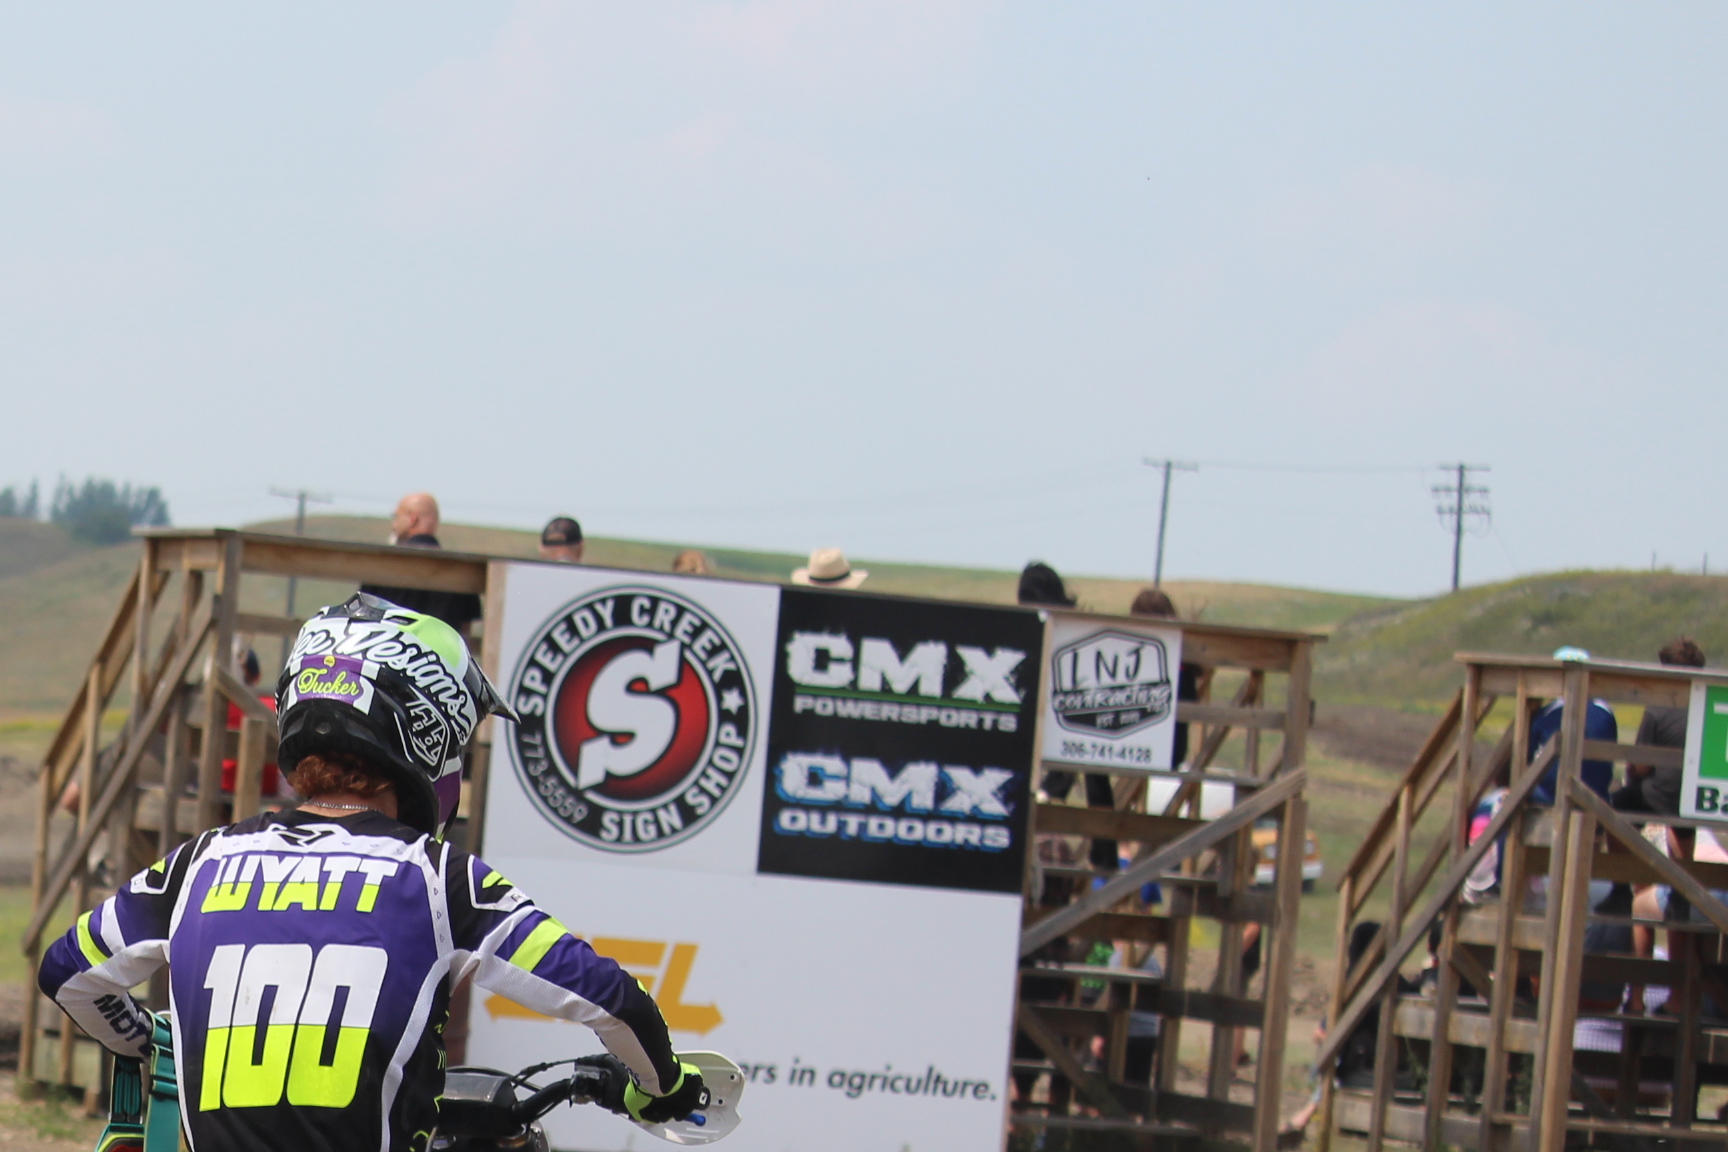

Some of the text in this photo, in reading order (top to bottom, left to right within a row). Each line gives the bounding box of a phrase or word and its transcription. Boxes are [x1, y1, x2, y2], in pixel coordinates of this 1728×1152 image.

[296, 667, 360, 697] Tucker
[335, 622, 474, 741] Designs
[516, 595, 738, 717] SPEEDY CREEK
[785, 630, 1027, 704] CMX
[792, 694, 1019, 733] POWERSPORTS
[599, 721, 746, 843] SIGN SHOP
[775, 750, 1016, 820] CMX
[775, 806, 1012, 851] OUTDOORS
[200, 854, 399, 914] WYATT
[199, 943, 389, 1112] 100
[788, 1056, 816, 1087] in
[826, 1063, 998, 1101] agriculture.
